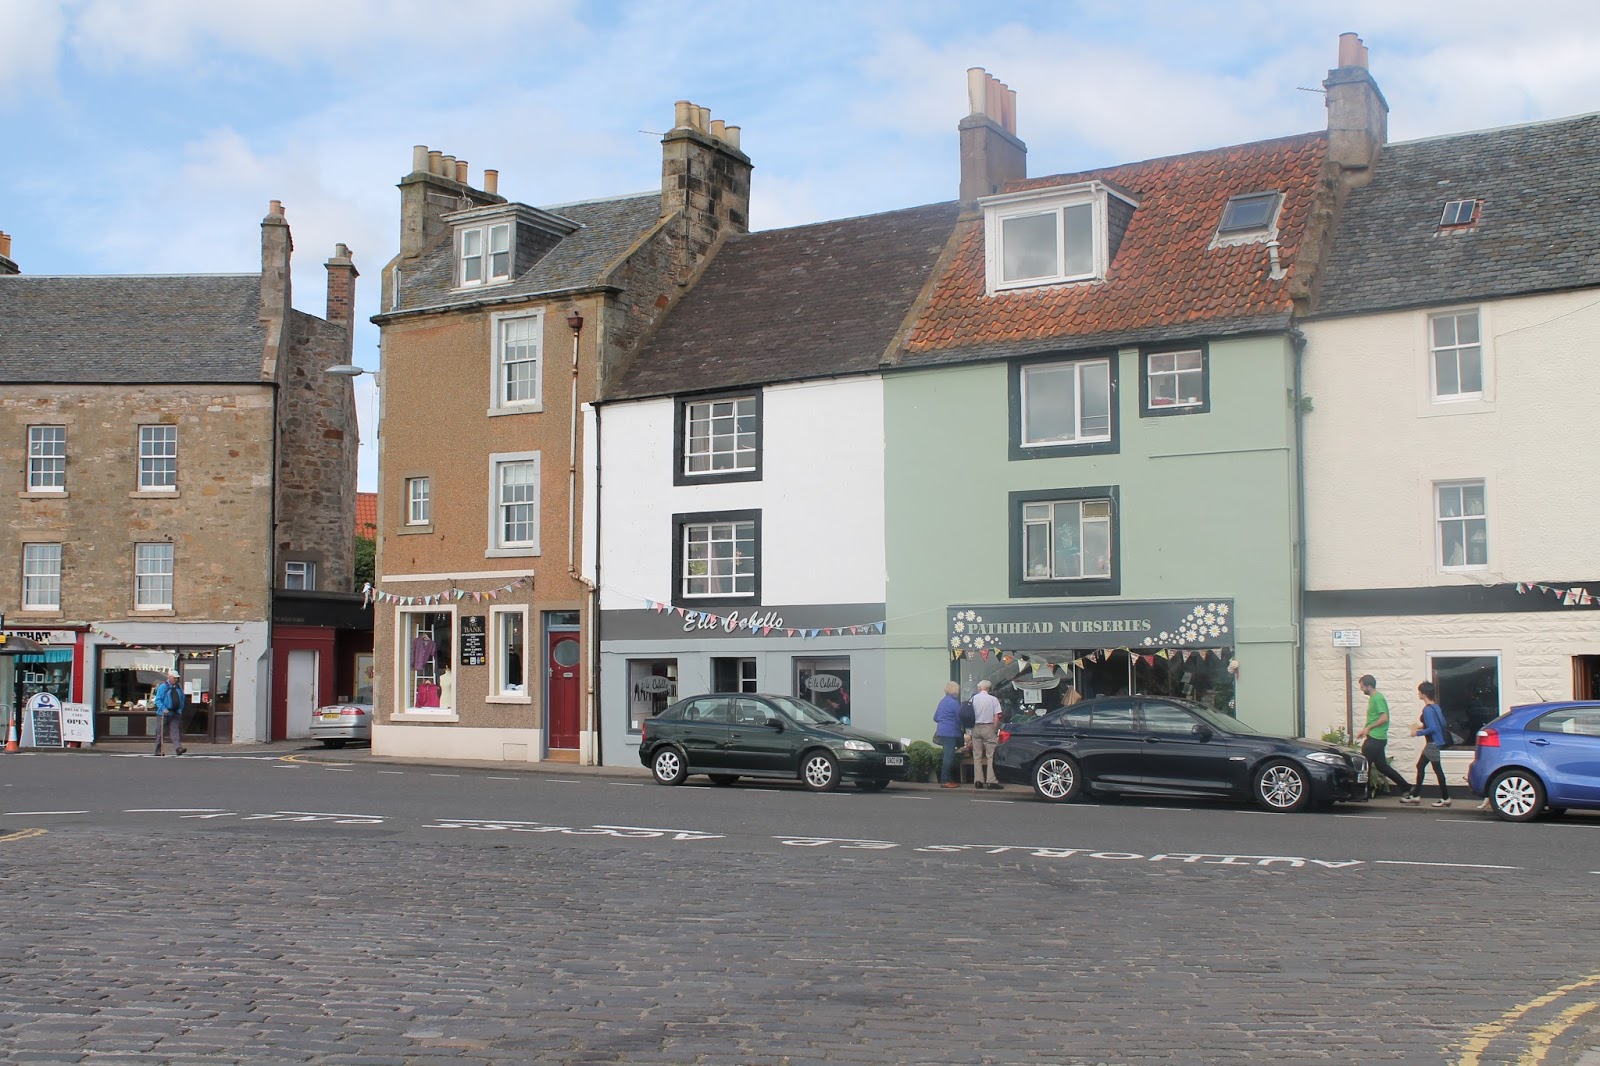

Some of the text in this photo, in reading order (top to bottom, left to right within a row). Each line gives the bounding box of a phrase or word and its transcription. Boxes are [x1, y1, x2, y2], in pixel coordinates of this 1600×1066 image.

[683, 612, 718, 632] Elle
[967, 619, 1152, 635] PATHHEAD NURSERIES
[16, 631, 52, 642] THAT
[66, 718, 89, 726] OPEN
[421, 823, 727, 840] ACCESS
[781, 839, 1366, 869] AUTHORISED
